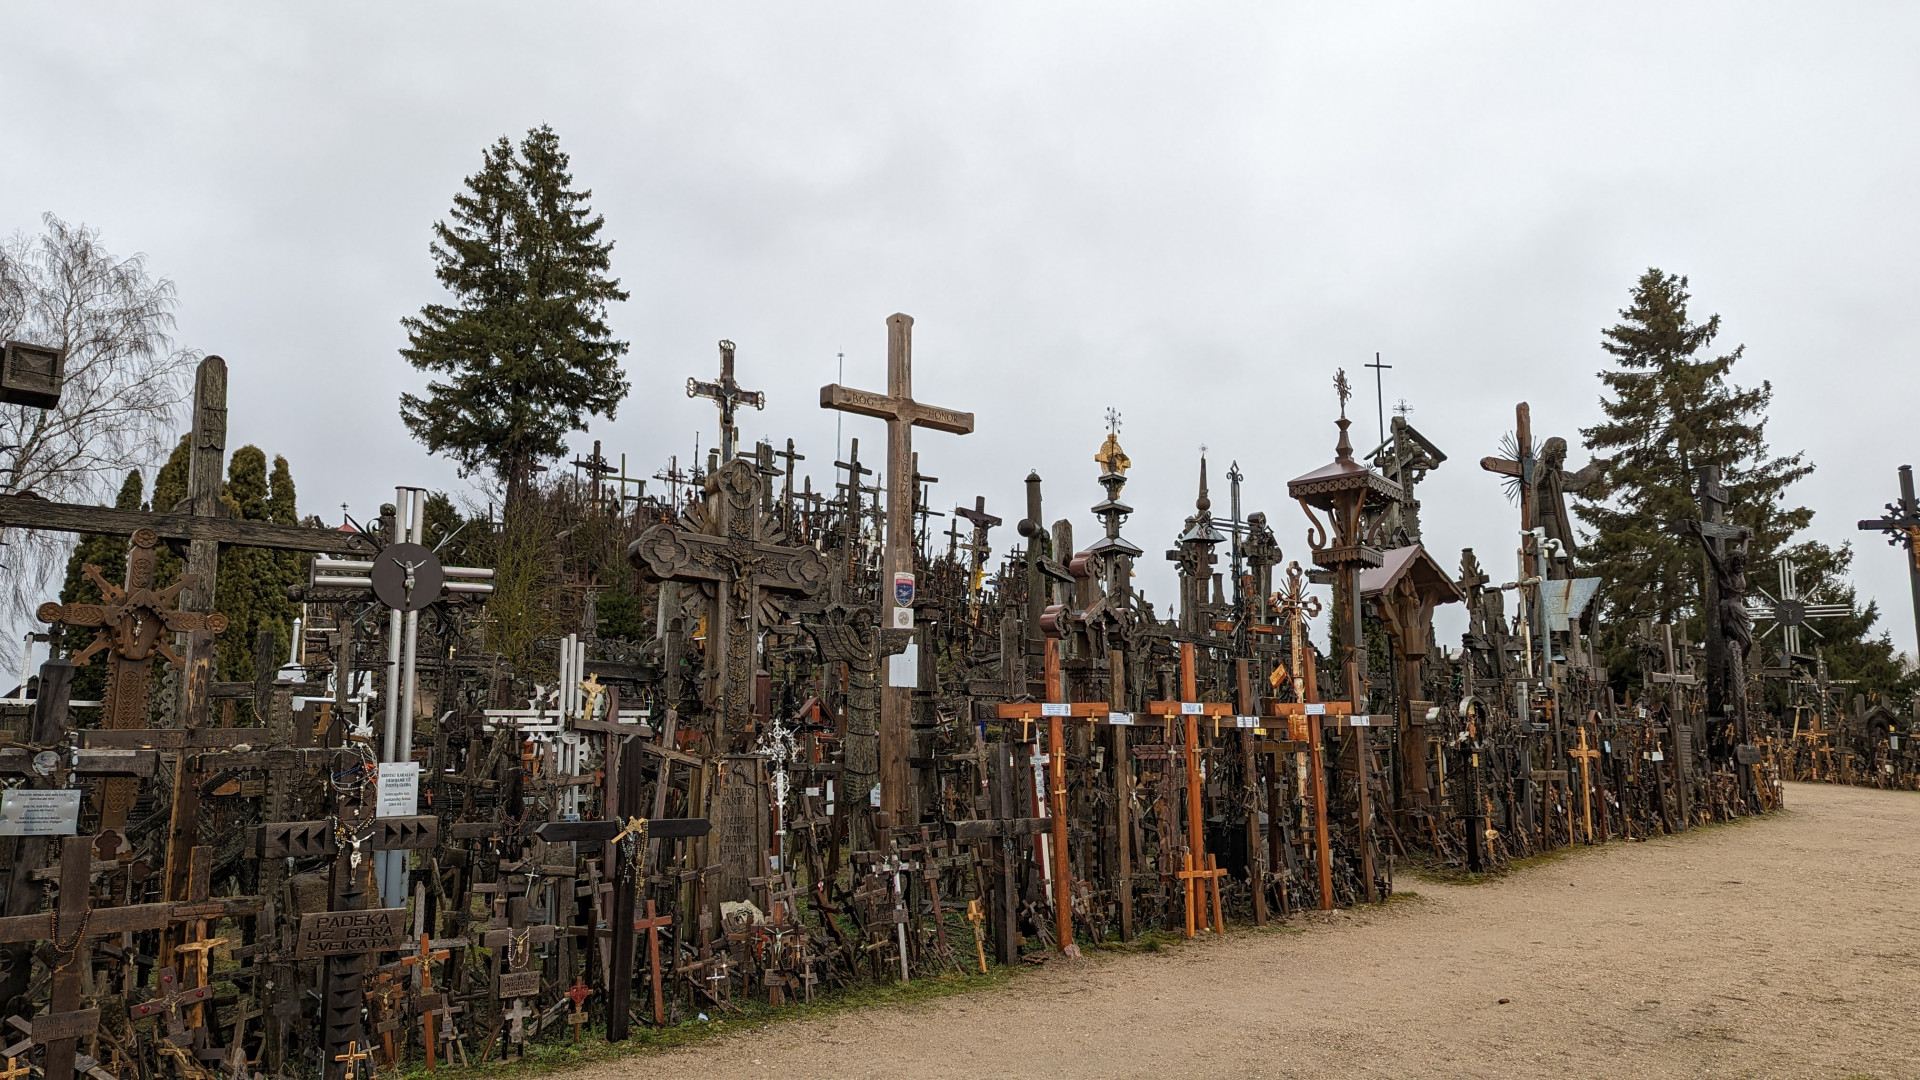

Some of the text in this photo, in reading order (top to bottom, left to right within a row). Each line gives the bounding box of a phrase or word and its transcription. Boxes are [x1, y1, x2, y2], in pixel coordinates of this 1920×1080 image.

[852, 393, 874, 406] BOG
[317, 913, 390, 929] PADEKA
[346, 926, 393, 939] GERA
[306, 938, 390, 952] SVEIKATA
